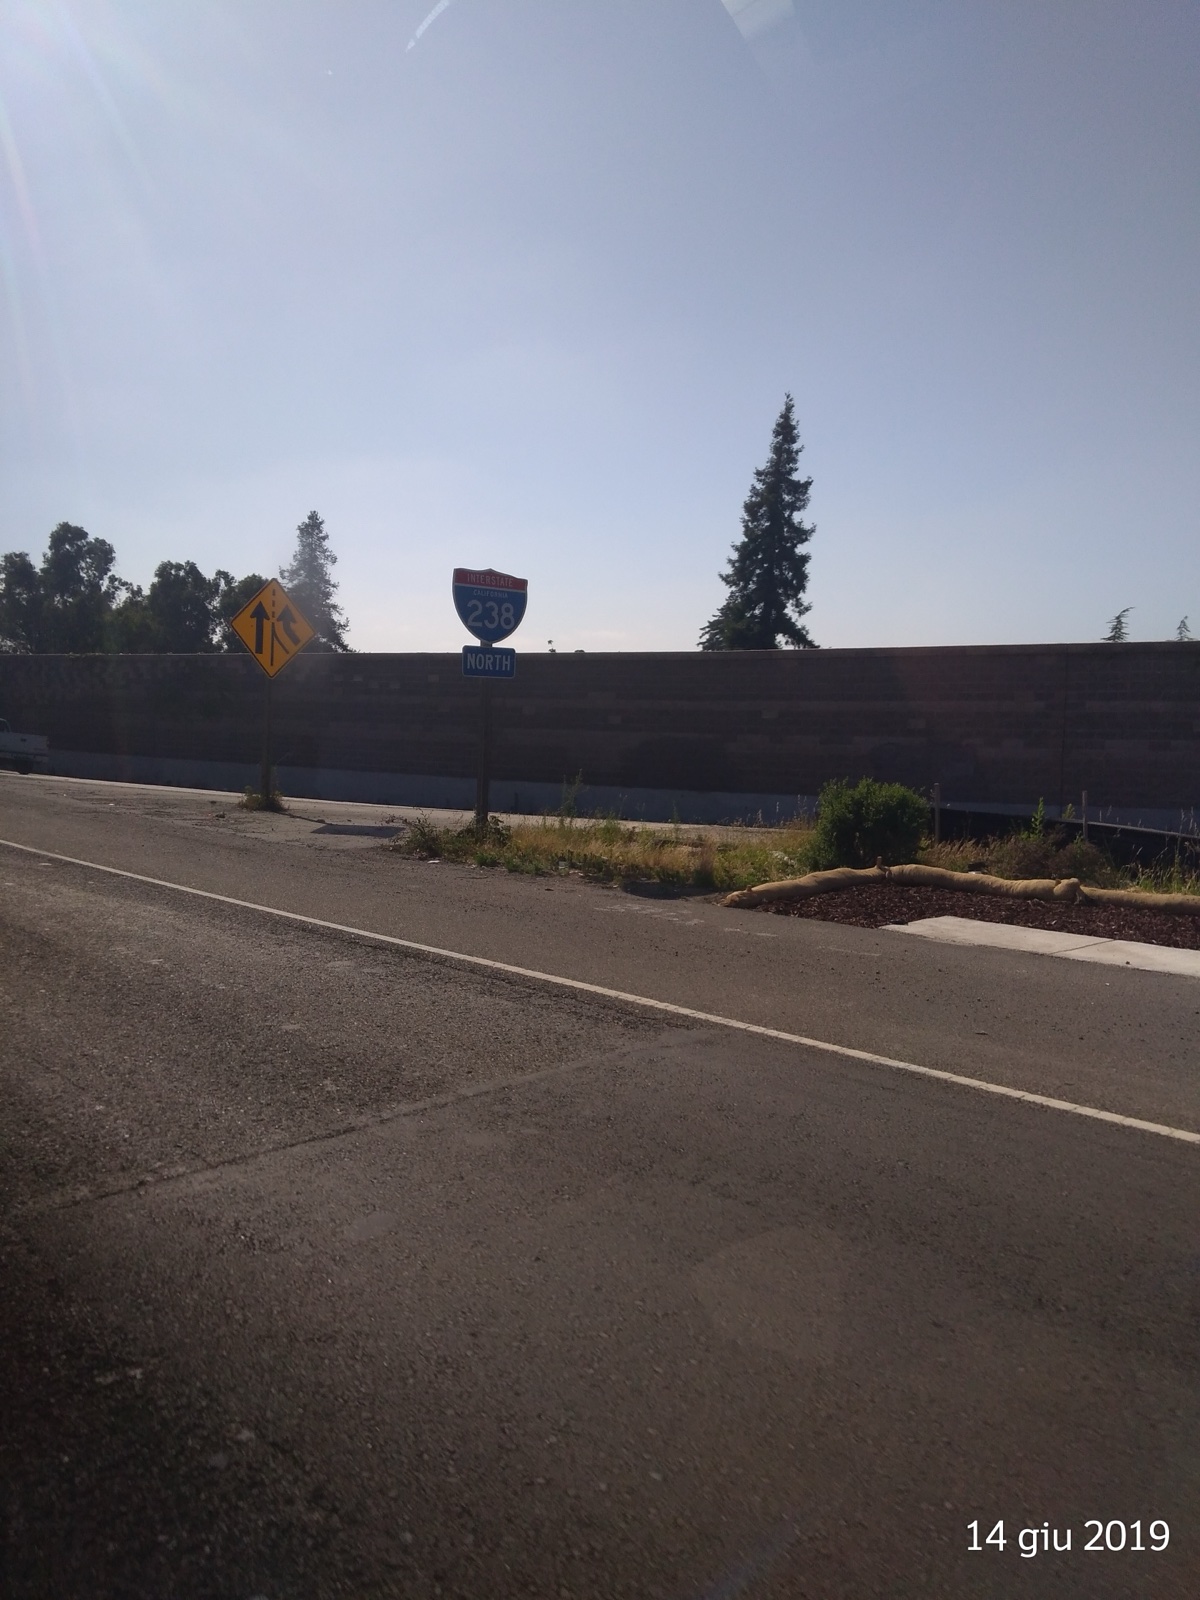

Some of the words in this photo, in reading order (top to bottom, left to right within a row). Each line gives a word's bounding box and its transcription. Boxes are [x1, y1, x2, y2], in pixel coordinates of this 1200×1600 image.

[467, 573, 513, 587] INTERSTATE
[473, 589, 508, 598] CALIFORNIA
[467, 599, 515, 630] 238
[466, 653, 511, 671] NORTH
